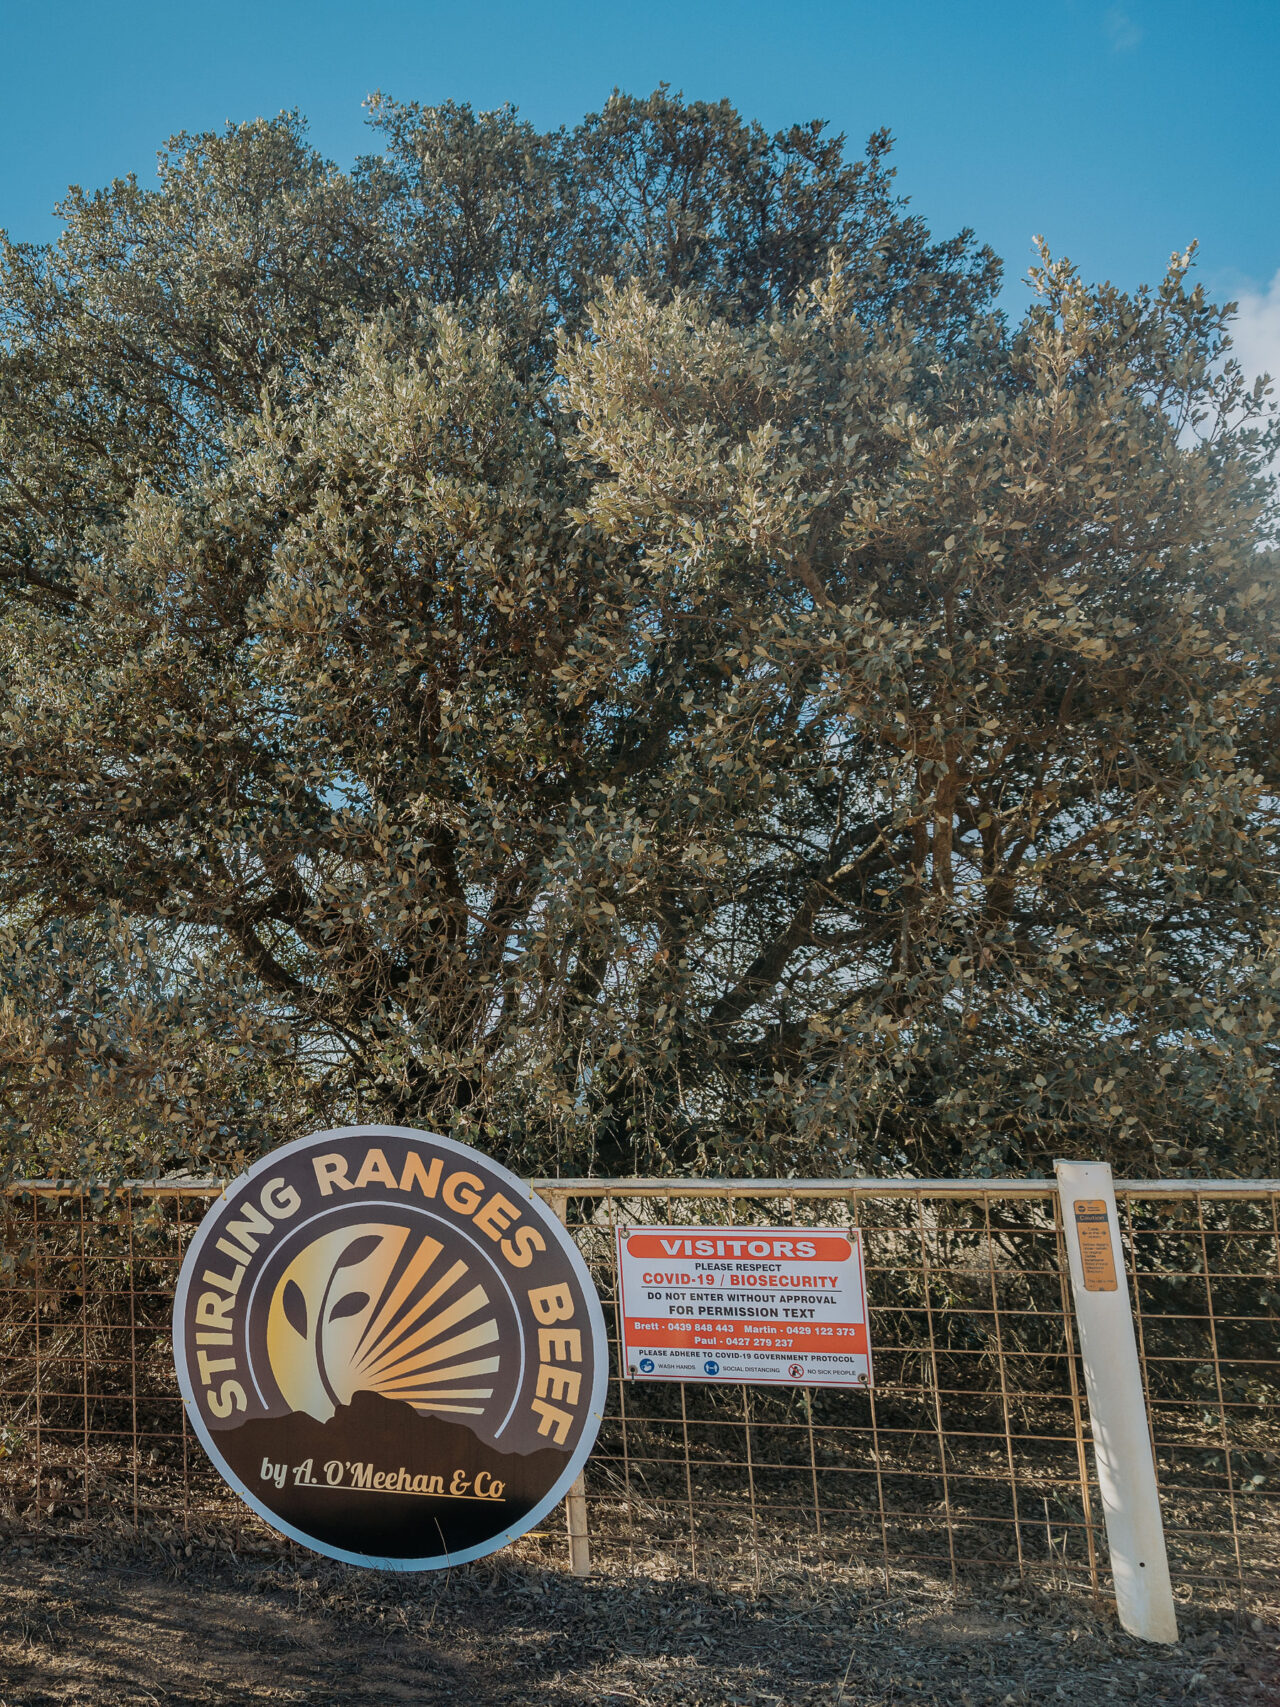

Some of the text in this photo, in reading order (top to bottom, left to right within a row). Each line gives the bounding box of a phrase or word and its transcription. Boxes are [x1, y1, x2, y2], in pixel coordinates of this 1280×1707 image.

[660, 1240, 816, 1257] VISITORS
[695, 1263, 781, 1272] PLEASE RESPECT
[643, 1273, 838, 1288] COVID-19 / BIOSECURITY
[195, 1147, 583, 1445] STIRLING RANGES BEEF
[666, 1293, 686, 1301] NOT
[690, 1293, 723, 1301] ENTER
[727, 1294, 776, 1302] WITHOUT
[780, 1295, 837, 1304] APPROVAL
[669, 1306, 815, 1318] FOR PERMISSION TEXT
[634, 1322, 659, 1330] Brett
[668, 1323, 692, 1331] 0439
[694, 1324, 712, 1332] 848
[716, 1324, 733, 1333] 443
[744, 1325, 776, 1333] Martin
[786, 1326, 811, 1335] 0429
[815, 1327, 833, 1336] 122
[836, 1328, 855, 1336] 373
[694, 1337, 716, 1345] Paul
[726, 1338, 750, 1346] 0427
[753, 1339, 772, 1347] 279
[775, 1339, 793, 1347] 237
[716, 1352, 751, 1360] COVID-19
[754, 1354, 808, 1362] GOVERNMENT
[811, 1355, 854, 1363] PROTOCOL
[260, 1457, 287, 1488] by
[293, 1459, 318, 1485] A.
[450, 1469, 472, 1496] &
[474, 1471, 505, 1498] Co
